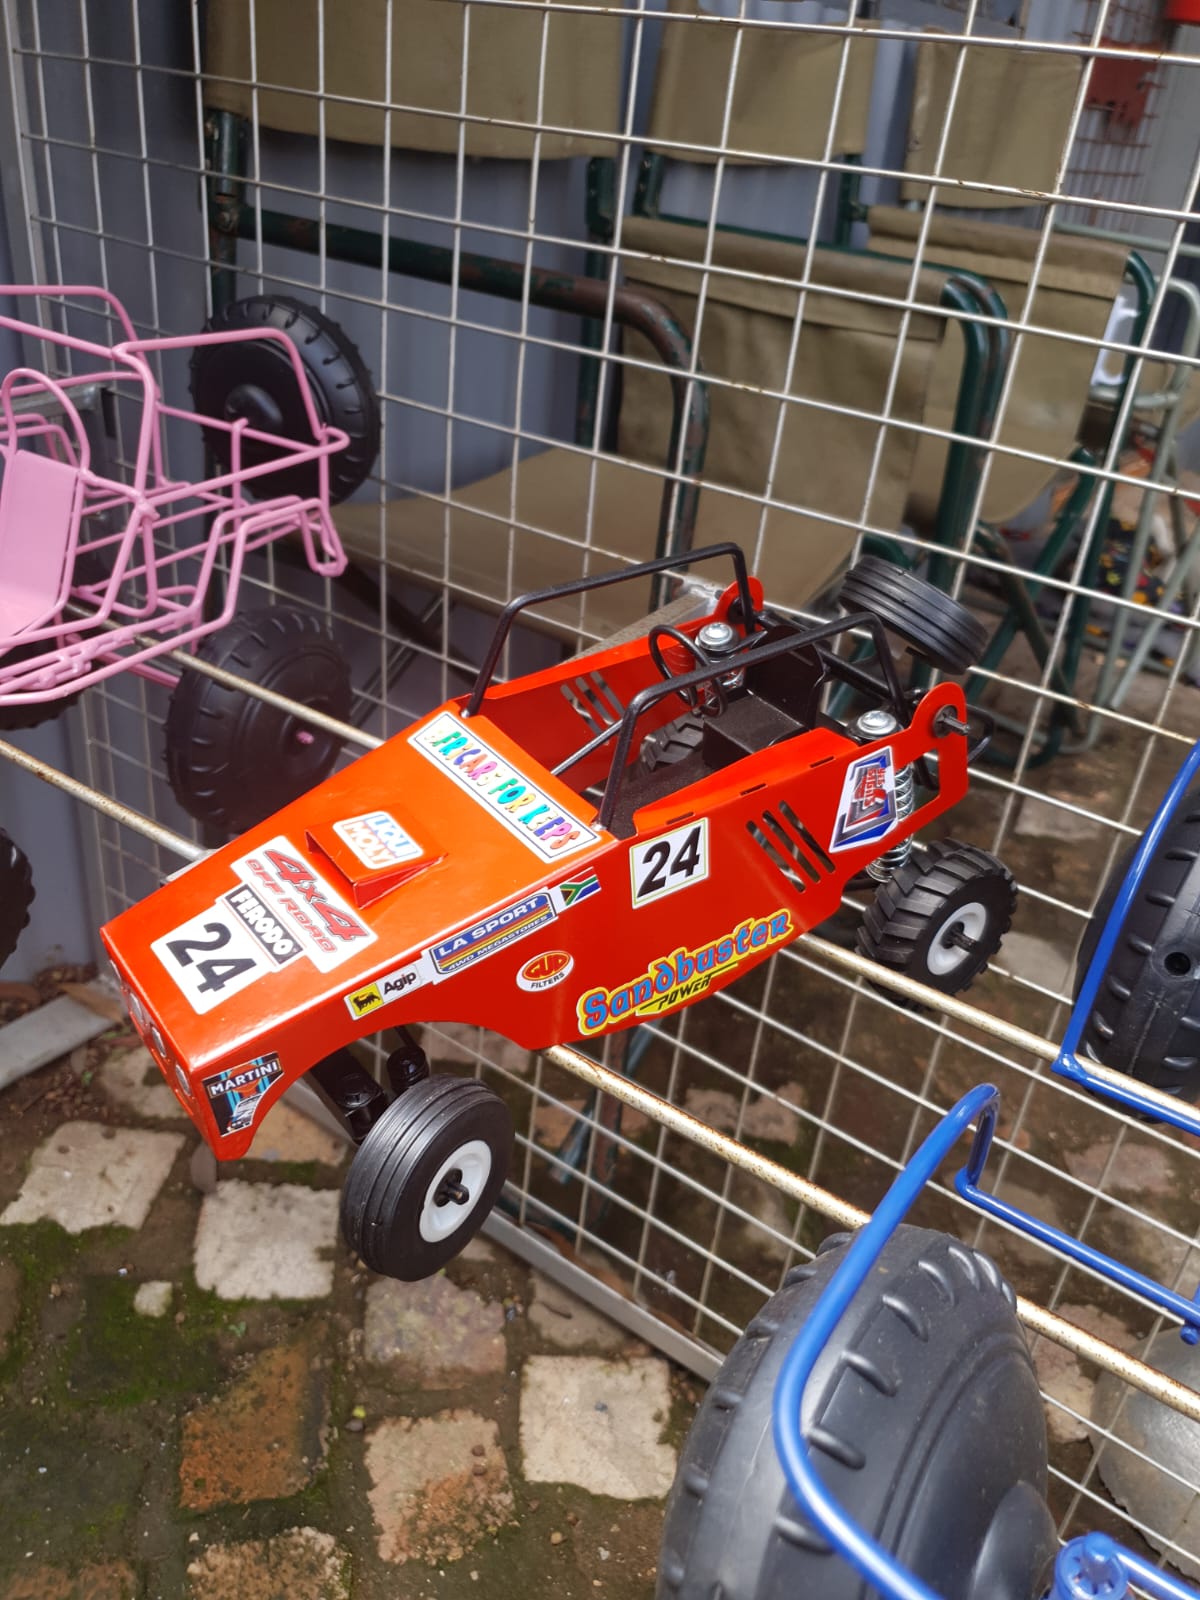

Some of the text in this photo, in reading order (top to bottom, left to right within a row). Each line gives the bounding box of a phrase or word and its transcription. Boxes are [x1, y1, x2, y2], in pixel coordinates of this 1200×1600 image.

[424, 724, 506, 787] FRICARS
[488, 778, 536, 813] FOR
[636, 825, 702, 899] 24
[230, 888, 293, 956] FERODO
[245, 858, 337, 952] OFF ROAD
[438, 897, 538, 956] LA SPORT
[477, 914, 548, 955] MEGASTORES
[166, 922, 257, 993] 24
[383, 971, 417, 995] Agip
[531, 972, 565, 989] FILTERS
[580, 911, 792, 1030] Sandbuster
[657, 972, 713, 1011] POWER
[211, 1061, 278, 1095] MARTINI
